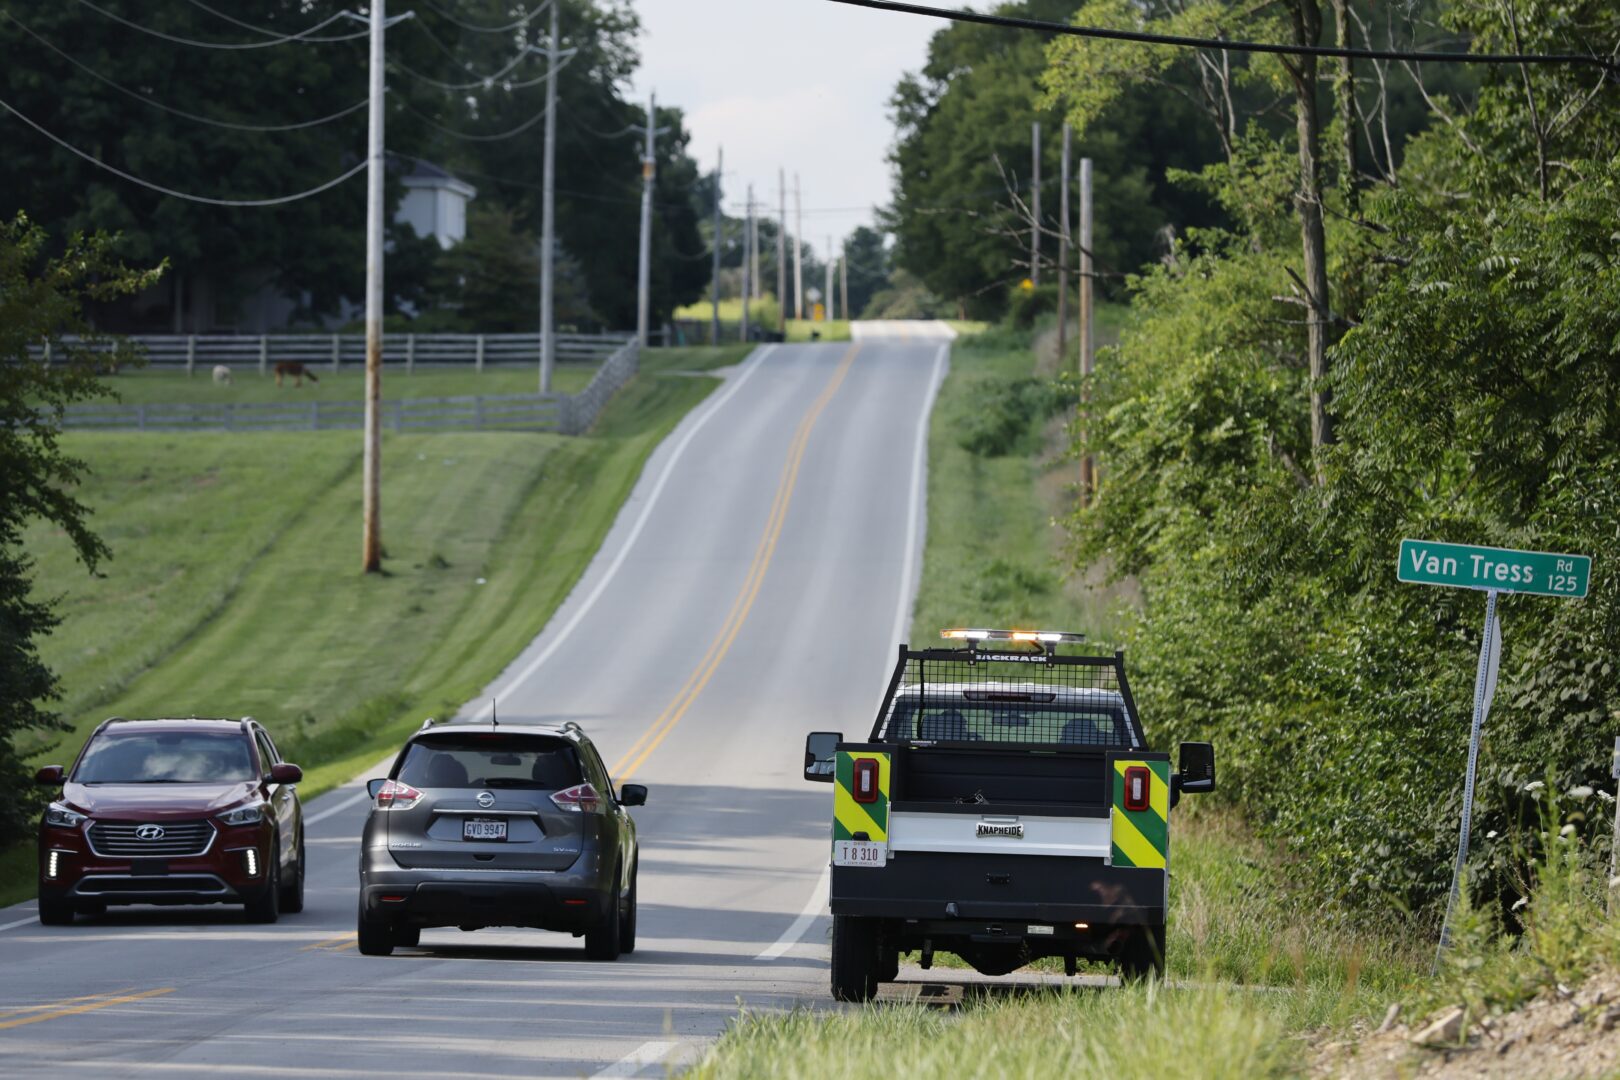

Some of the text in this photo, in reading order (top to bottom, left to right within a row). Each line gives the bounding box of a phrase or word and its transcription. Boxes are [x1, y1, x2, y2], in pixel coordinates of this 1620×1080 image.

[1410, 549, 1534, 583] Van Tress
[1556, 559, 1573, 572] Rd
[1548, 574, 1577, 592] 125
[484, 824, 504, 836] 9947
[978, 824, 1022, 837] KNAPHEIDE
[843, 847, 878, 861] T 8 310
